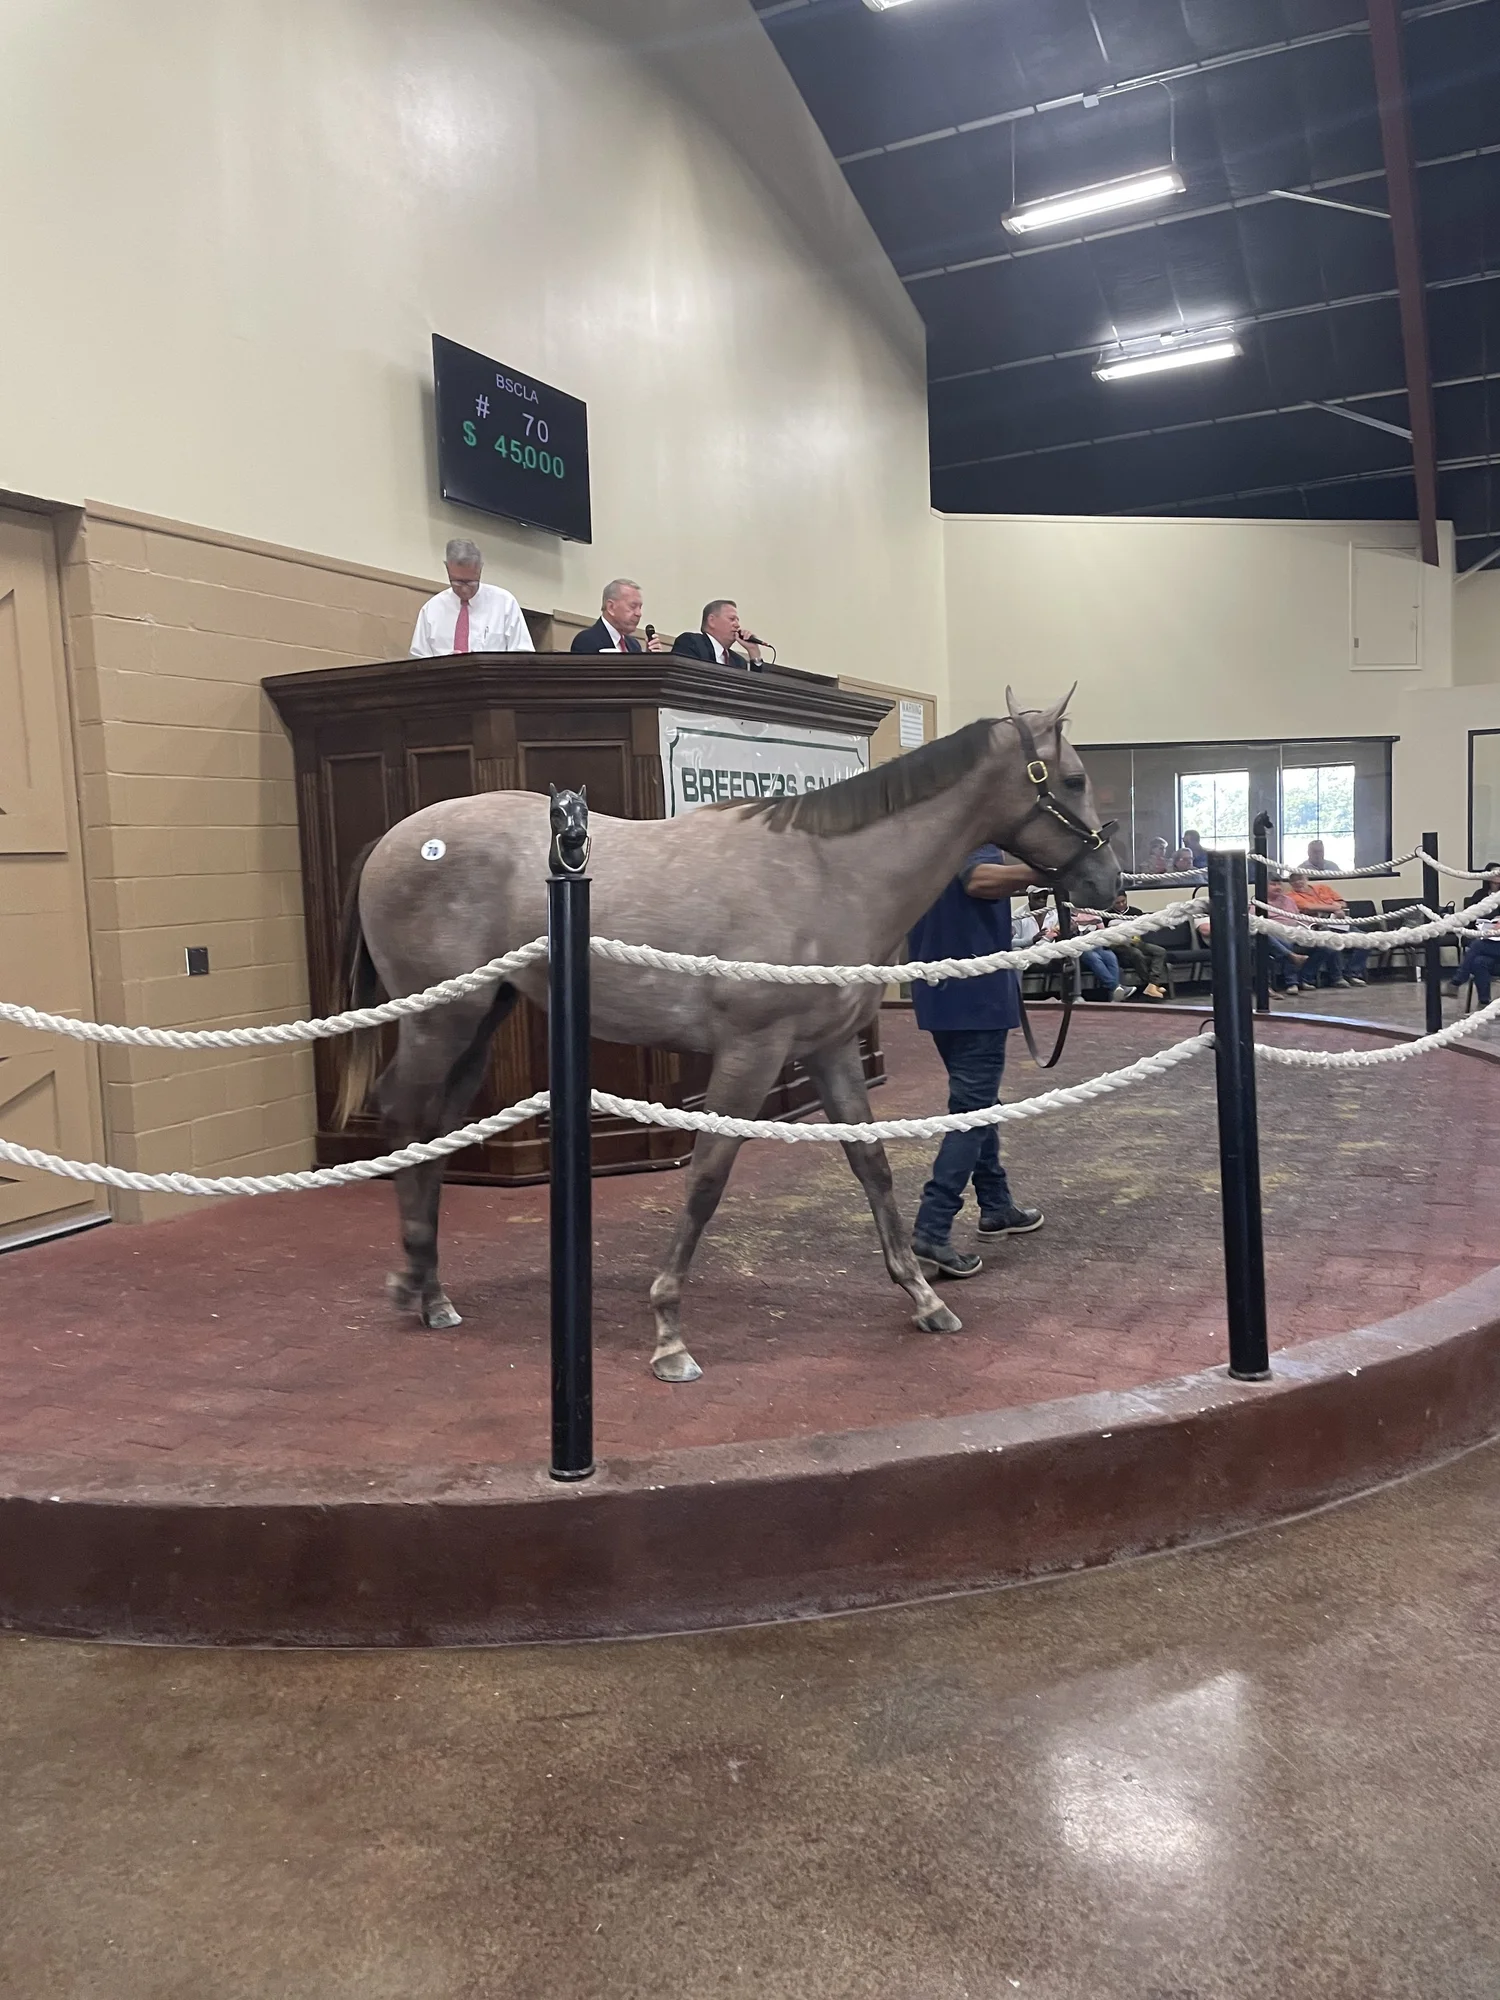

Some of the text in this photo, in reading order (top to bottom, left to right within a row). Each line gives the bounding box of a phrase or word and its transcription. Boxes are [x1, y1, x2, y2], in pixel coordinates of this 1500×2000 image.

[496, 373, 539, 404] BSCLA
[475, 394, 549, 443] # 70
[462, 420, 565, 479] $ 45,000
[681, 767, 798, 802] BREEDERS
[426, 846, 439, 857] 70
